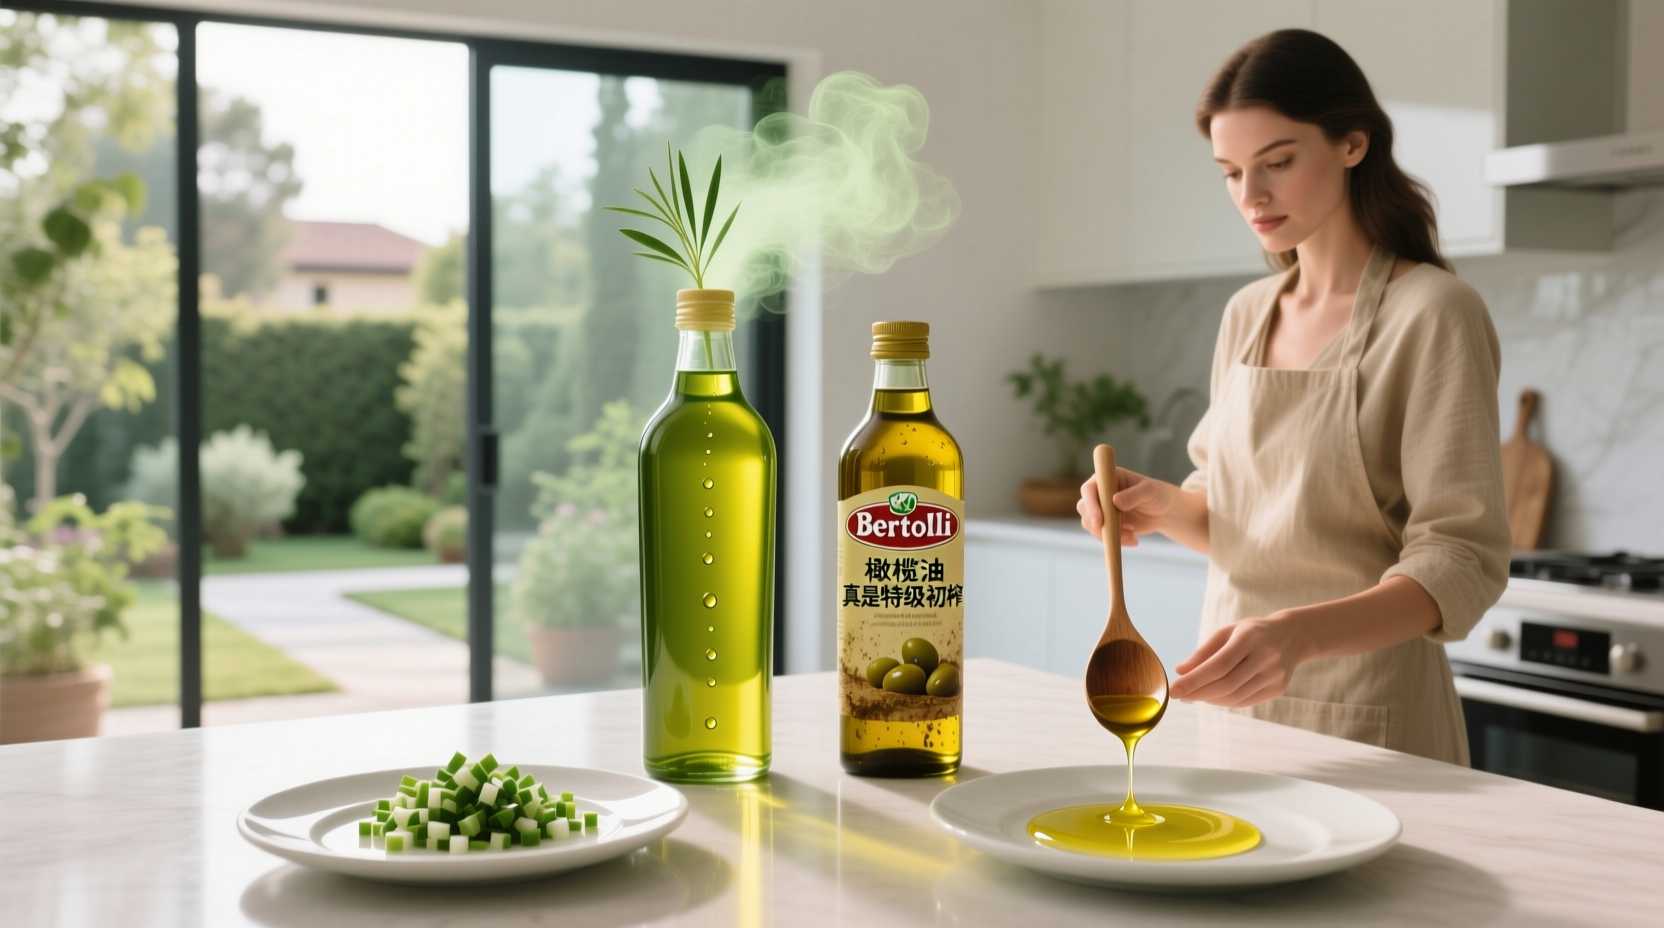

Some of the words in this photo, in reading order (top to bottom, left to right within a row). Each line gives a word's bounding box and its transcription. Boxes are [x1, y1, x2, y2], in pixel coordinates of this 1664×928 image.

[856, 511, 952, 538] Bertolli
[865, 557, 944, 583] 橄榄油
